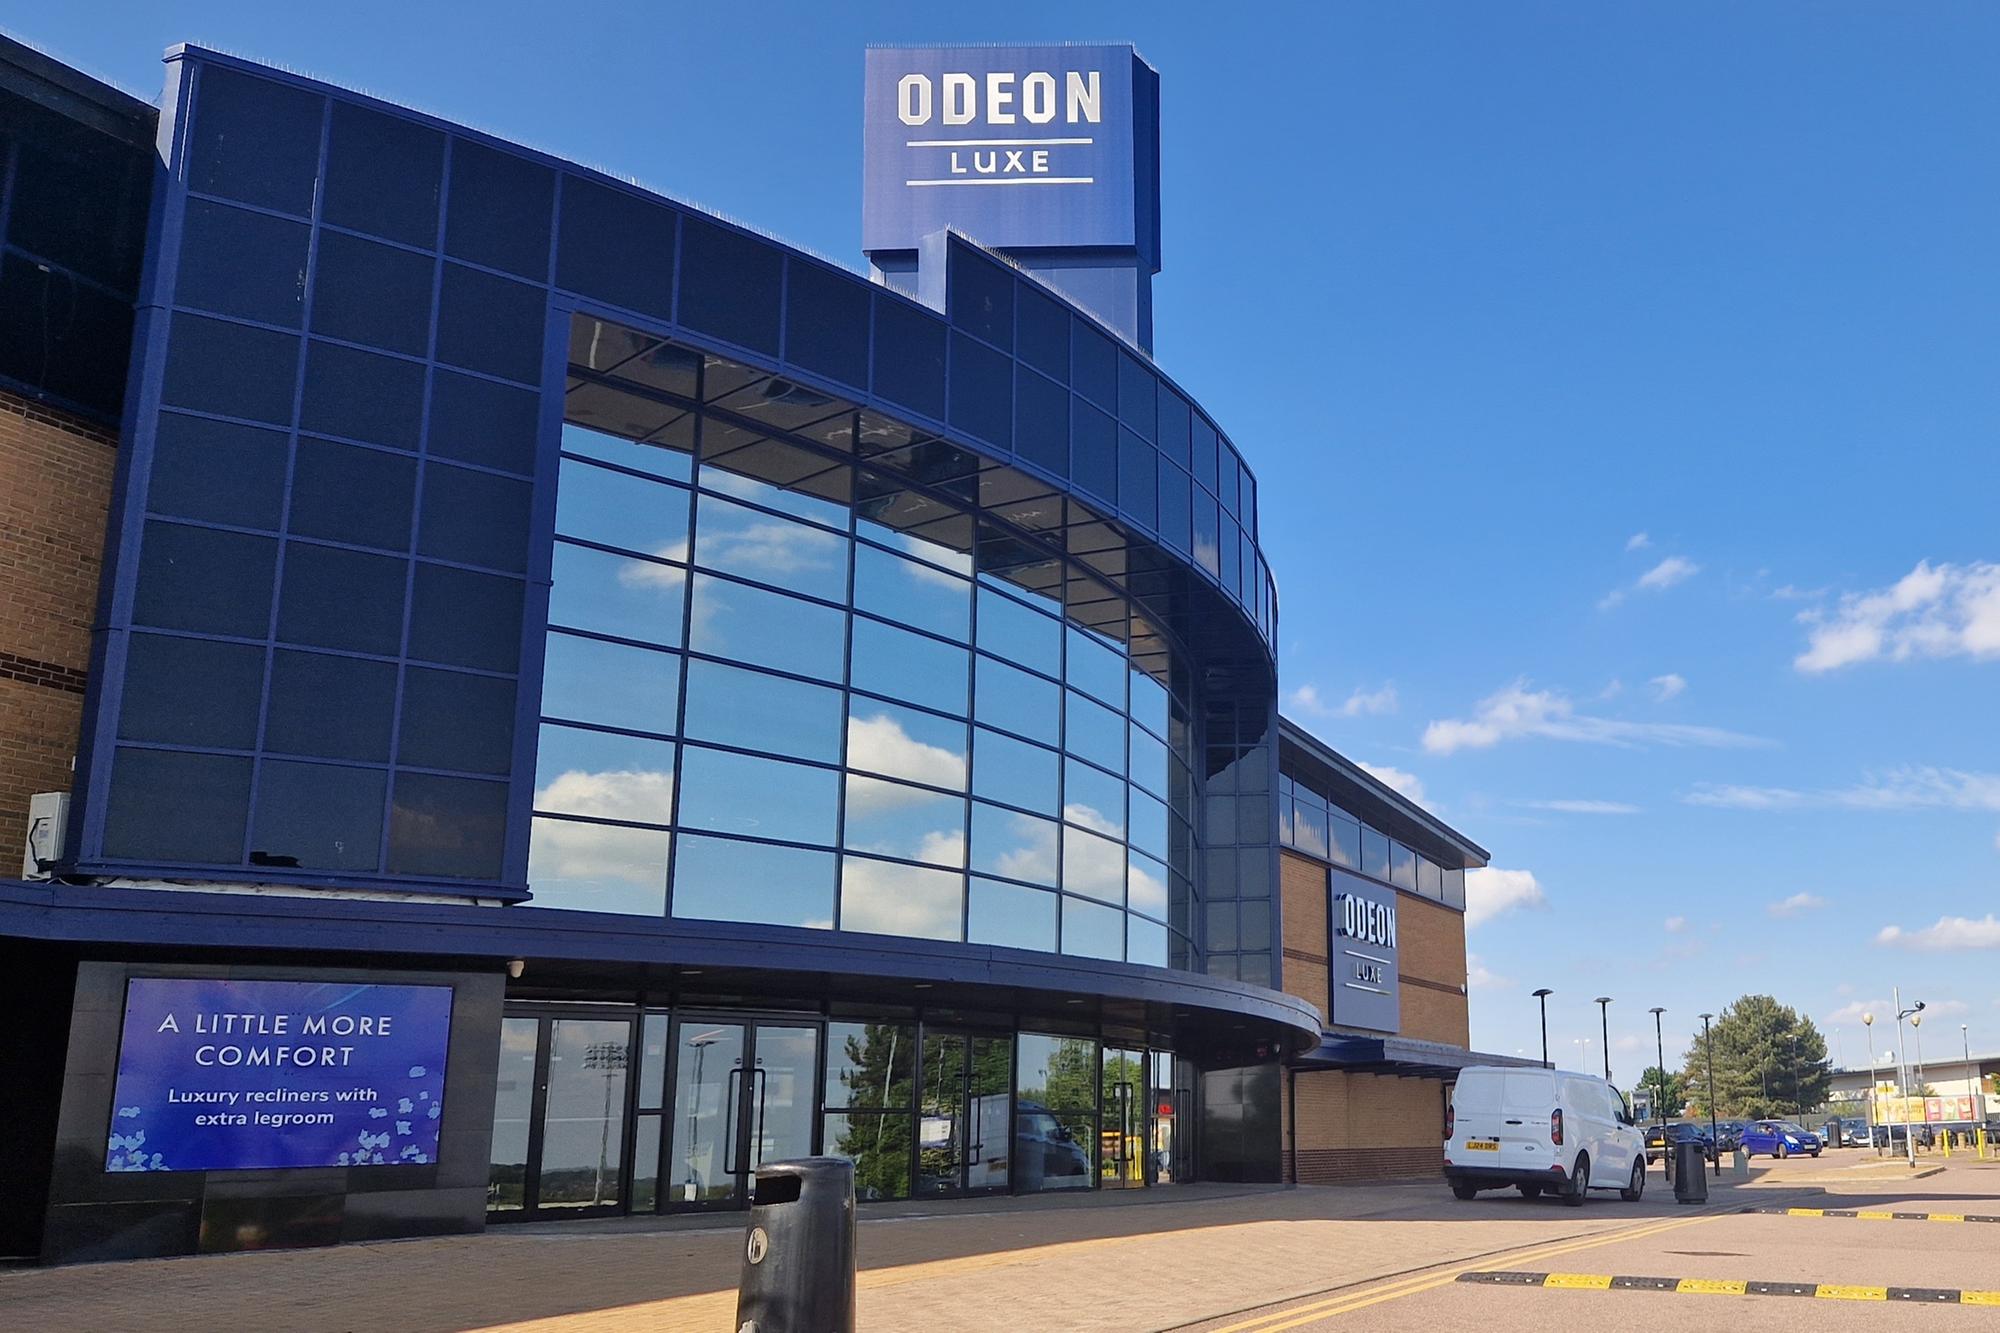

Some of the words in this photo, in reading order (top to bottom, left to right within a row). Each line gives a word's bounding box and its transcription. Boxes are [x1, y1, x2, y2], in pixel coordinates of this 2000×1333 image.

[898, 71, 1101, 125] ODEON
[951, 150, 1049, 173] LUXE
[1344, 893, 1396, 948] ODEON
[1356, 962, 1382, 983] LUXE
[157, 1013, 180, 1033] A
[196, 1013, 289, 1035] LITTLE
[302, 1015, 392, 1036] MORE
[195, 1046, 354, 1066] COMFORT
[168, 1088, 239, 1105] Luxury
[246, 1088, 329, 1102] recliners
[336, 1087, 378, 1102] with
[195, 1112, 247, 1126] extra
[254, 1111, 334, 1129] legroom
